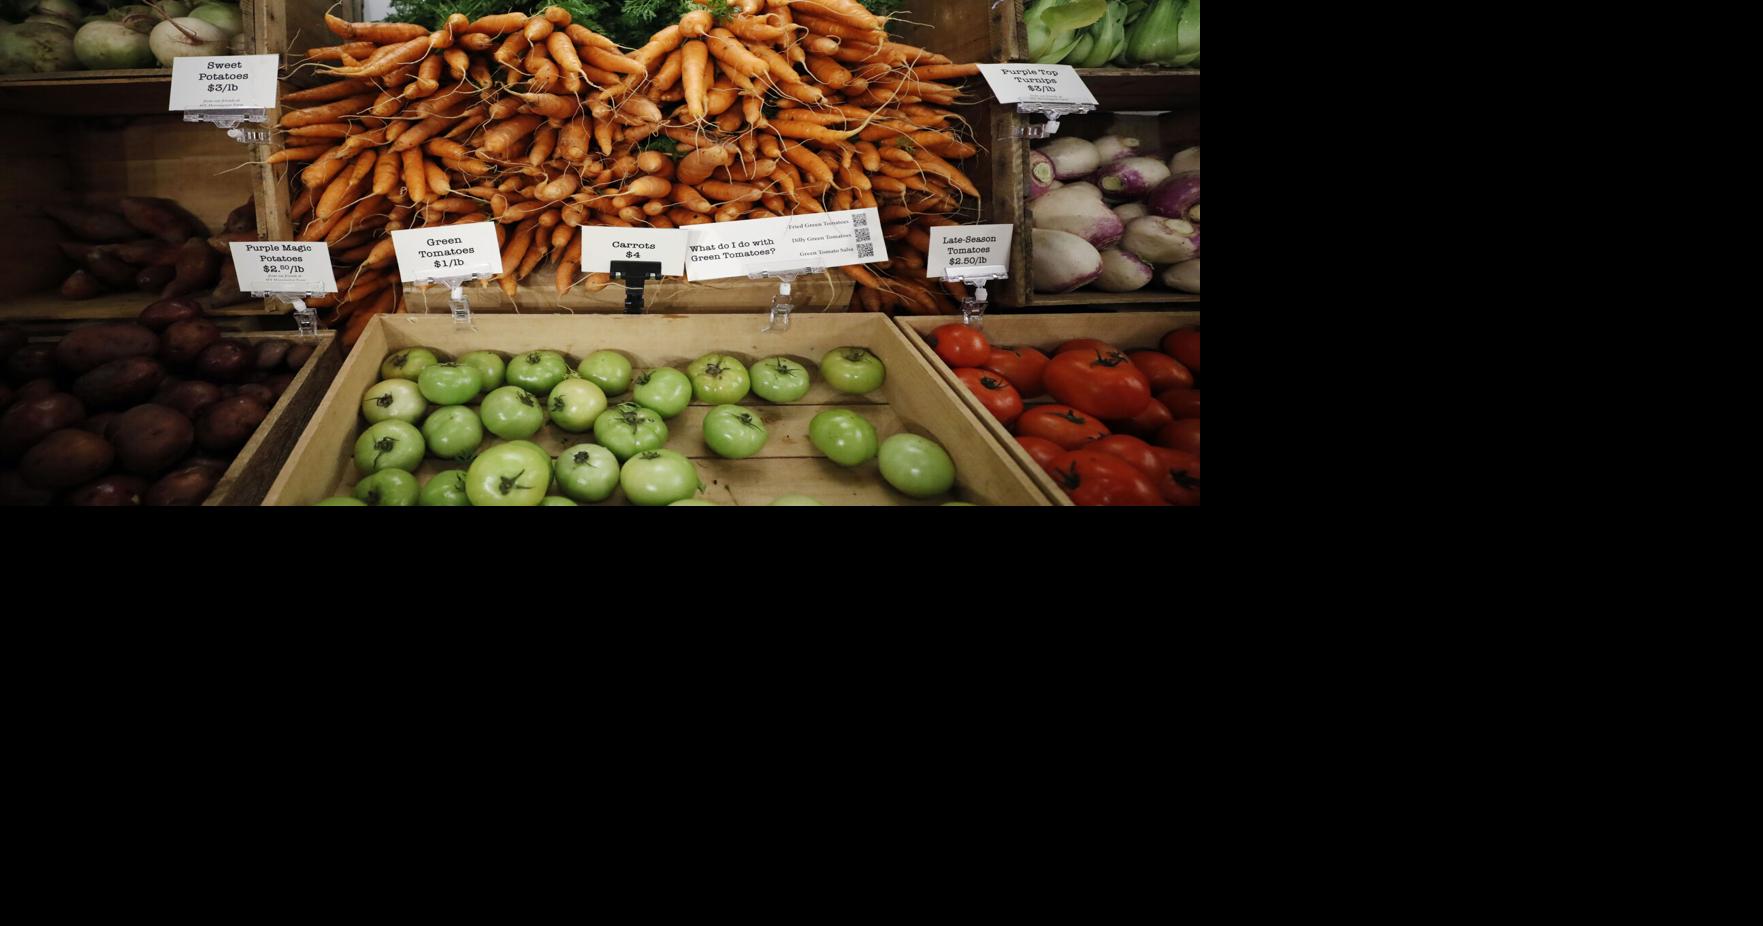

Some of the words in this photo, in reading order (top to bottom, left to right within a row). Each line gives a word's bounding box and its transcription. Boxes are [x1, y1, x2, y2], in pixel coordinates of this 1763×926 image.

[207, 61, 242, 70] Sweet
[1000, 68, 1038, 76] Purple
[1038, 69, 1059, 77] Top
[207, 83, 239, 93] $3/lb
[1028, 85, 1056, 93] $3/lb
[426, 236, 462, 247] Green
[942, 236, 997, 244] Late-Season
[246, 244, 280, 252] Purple
[282, 244, 312, 252] Magic
[612, 241, 656, 250] Carrots
[690, 244, 716, 252] What
[752, 238, 774, 246] with
[418, 247, 475, 258] Tomatoes
[625, 250, 640, 258] $4
[690, 254, 720, 262] Green
[722, 248, 776, 259] Tomatoes?
[947, 246, 990, 255] Tomatoes
[433, 258, 464, 268] $1/lb
[948, 256, 988, 266] $2.50/lb
